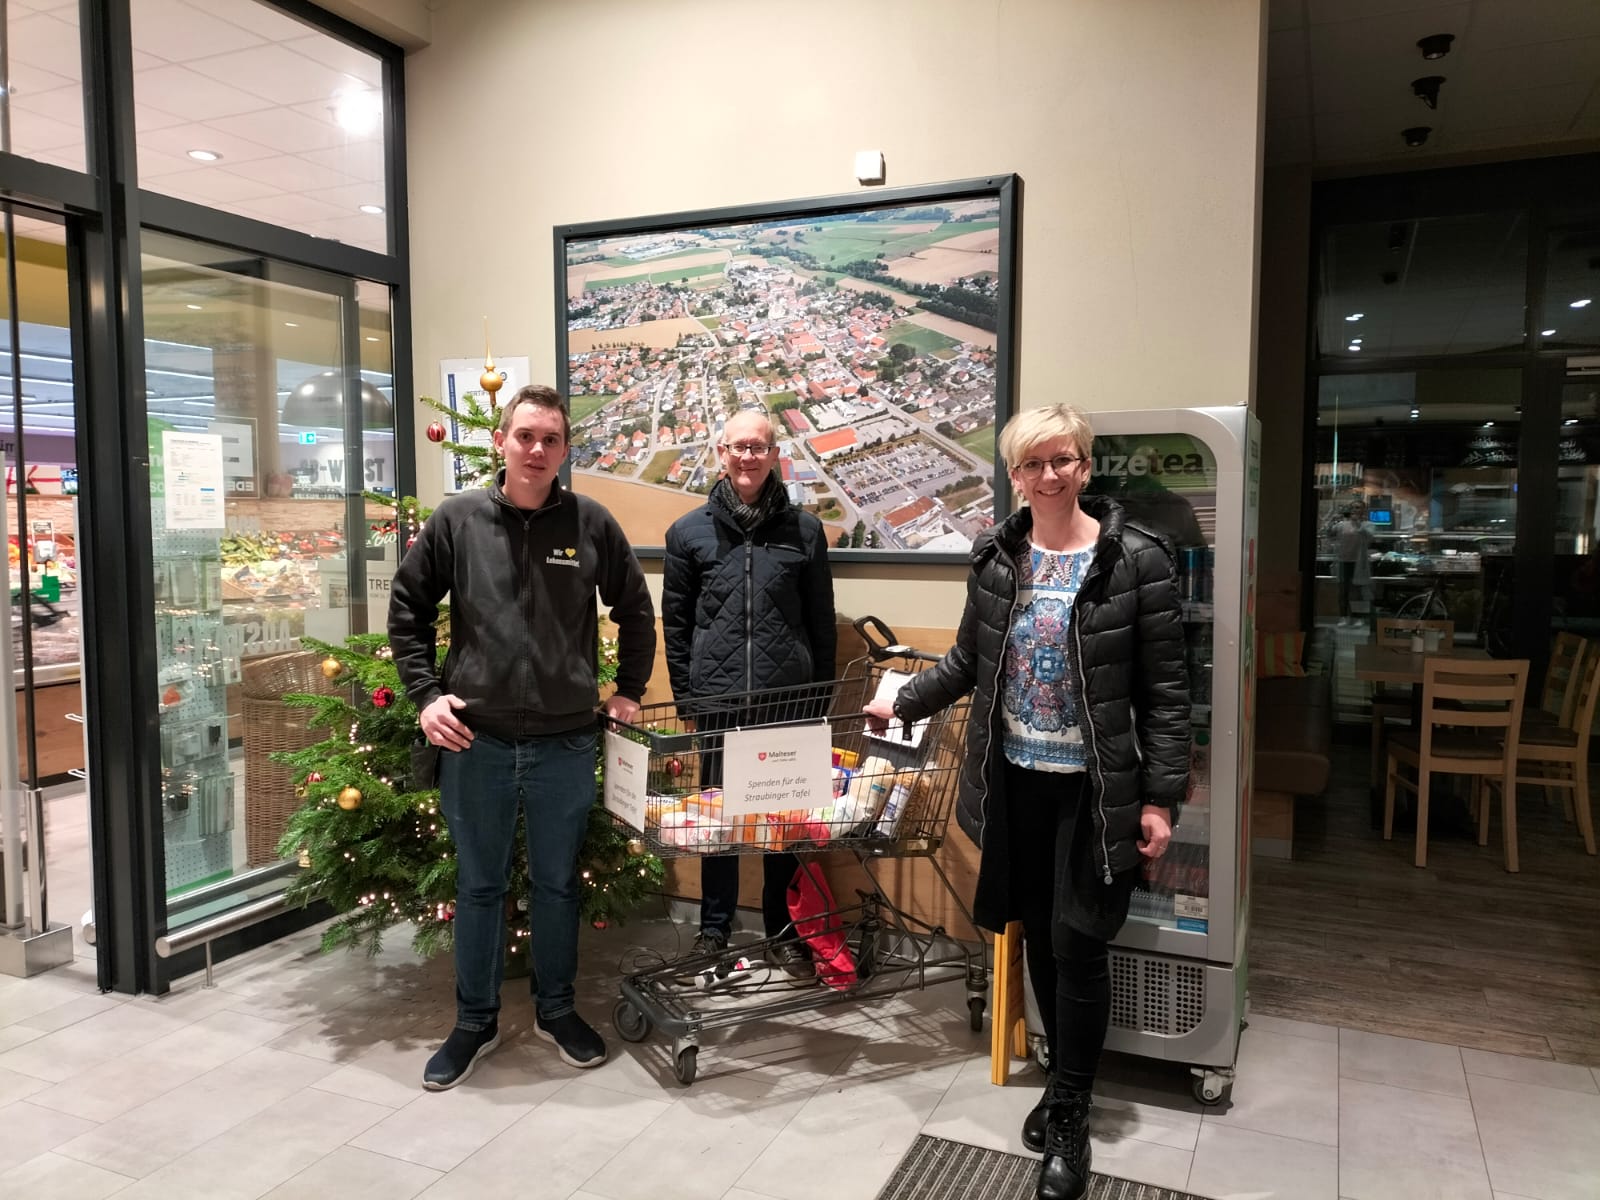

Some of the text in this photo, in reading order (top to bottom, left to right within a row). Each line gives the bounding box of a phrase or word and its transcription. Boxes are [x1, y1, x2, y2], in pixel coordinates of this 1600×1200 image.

[1092, 448, 1203, 477] uzetea
[747, 776, 807, 789] Spenden für die
[744, 788, 811, 802] Straubinger Tafel
